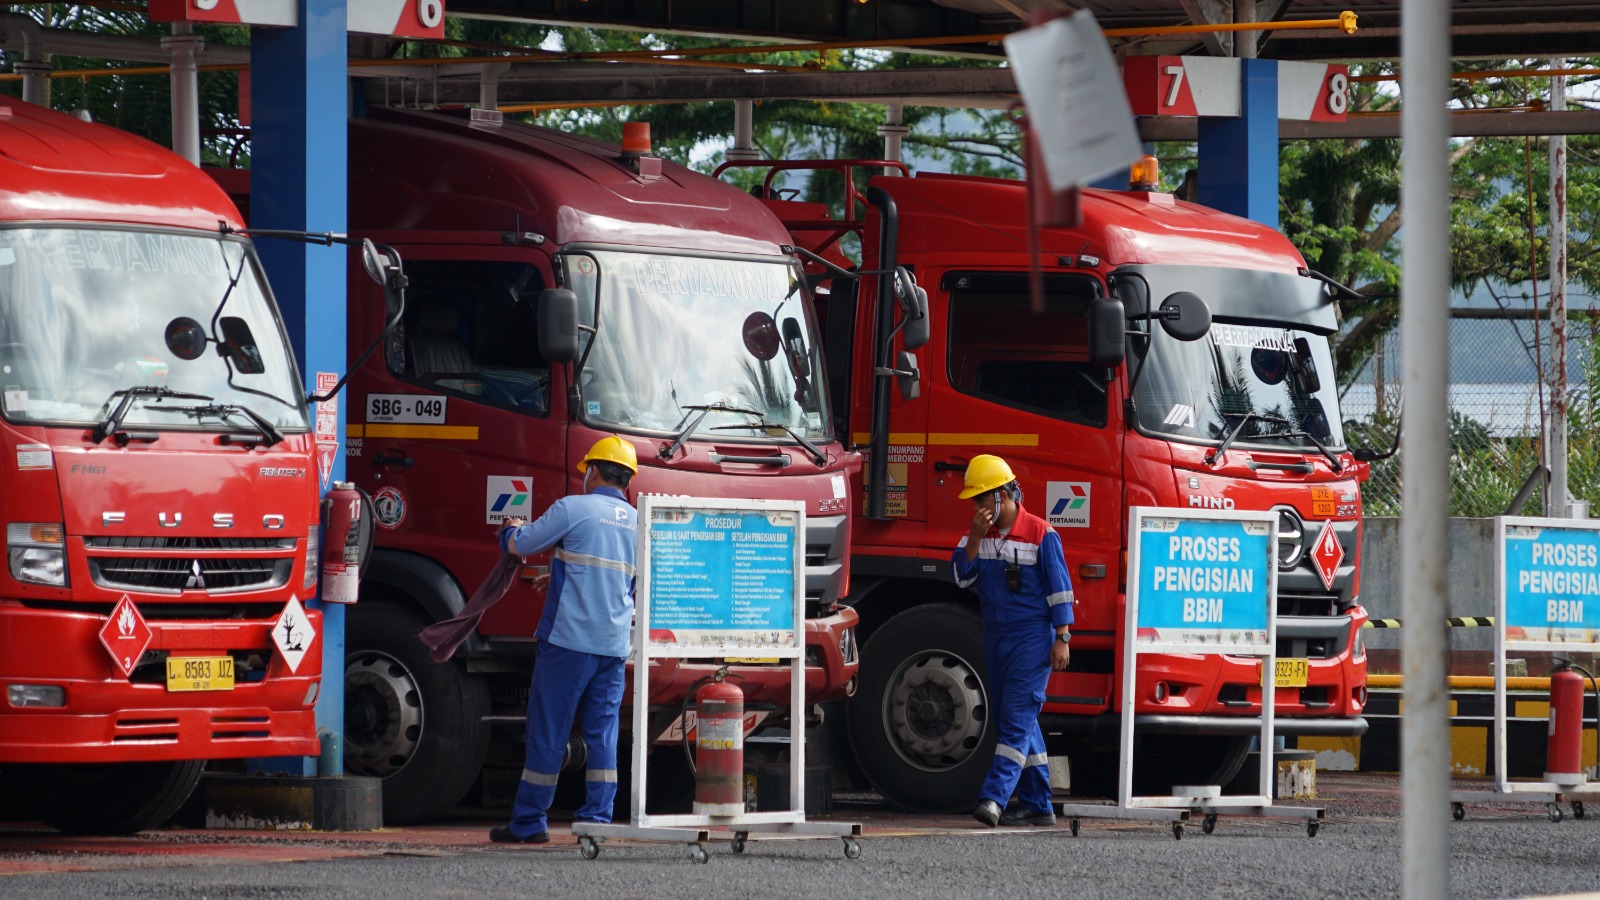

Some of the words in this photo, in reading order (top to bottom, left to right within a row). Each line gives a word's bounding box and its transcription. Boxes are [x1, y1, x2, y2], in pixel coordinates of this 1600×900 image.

[1164, 65, 1184, 107] 7
[1327, 73, 1348, 115] 8
[633, 259, 786, 302] PERTAMINA
[1211, 324, 1298, 353] PERTAMINA
[371, 399, 402, 416] SBG
[414, 399, 442, 418] 049
[588, 403, 600, 411] OK
[888, 446, 925, 455] ENUMPANG
[886, 492, 906, 501] SPOT
[1188, 494, 1236, 510] HINO
[101, 510, 285, 529] FUSO
[705, 517, 742, 529] PROSEDUR
[1049, 517, 1087, 525] PERTAMINA
[731, 532, 751, 542] SETELAH
[751, 532, 776, 542] PENGISIAN
[1169, 535, 1241, 562] PROSES
[1532, 543, 1598, 567] PROSES
[1153, 566, 1253, 593] PENGISIAN
[1326, 567, 1332, 579] 3
[1519, 570, 1600, 595] PENGISIA
[1182, 598, 1223, 623] BBM
[1546, 599, 1583, 623] BBM
[124, 657, 131, 669] 3
[168, 662, 176, 679] L
[185, 660, 211, 679] 8583
